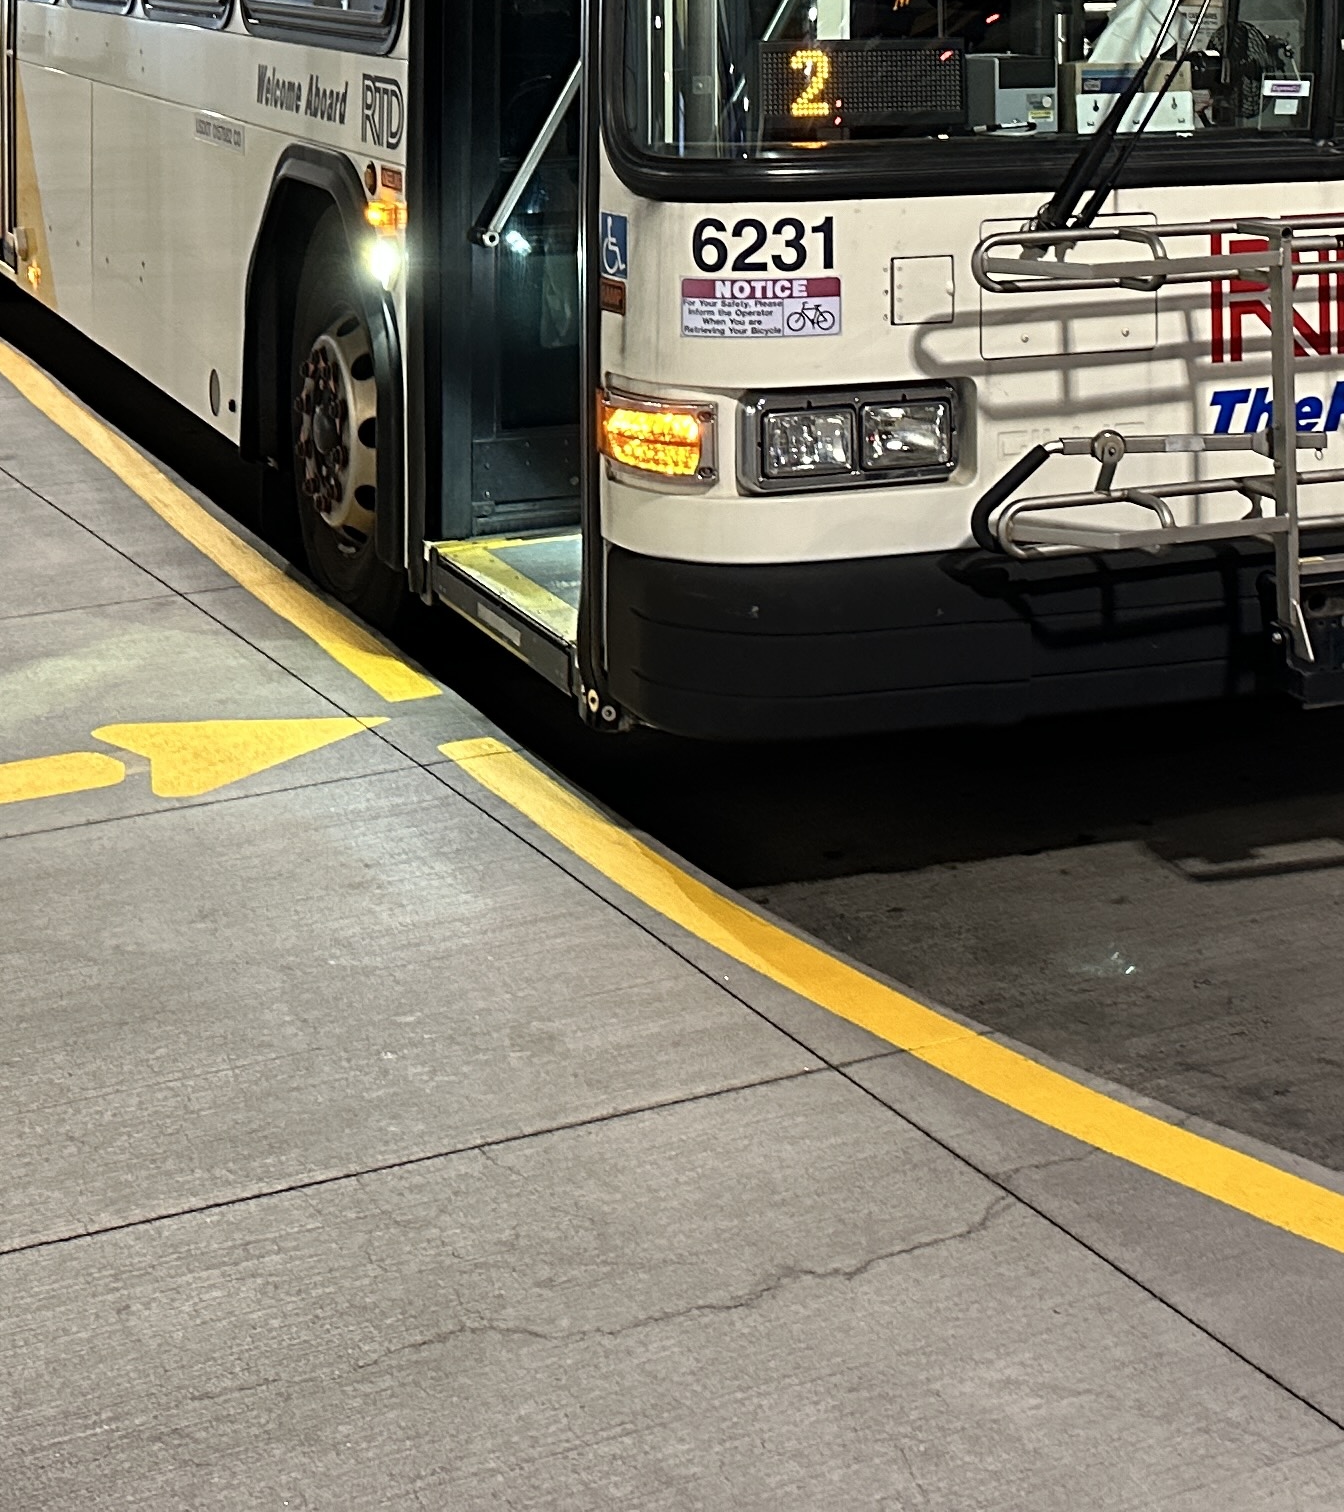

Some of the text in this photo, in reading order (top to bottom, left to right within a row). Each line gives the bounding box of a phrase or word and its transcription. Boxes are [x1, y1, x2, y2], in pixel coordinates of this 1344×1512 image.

[788, 48, 831, 118] 2
[256, 63, 349, 125] Welcome Aboard
[361, 73, 404, 150] RTD
[692, 215, 835, 273] 6231
[714, 279, 808, 299] NOTICE
[683, 300, 698, 308] For
[699, 300, 718, 308] Your
[754, 299, 783, 308] Please
[687, 308, 773, 318] Inform the Operator
[684, 326, 782, 336] Retrieving Your Bicycle
[702, 318, 762, 326] When You are
